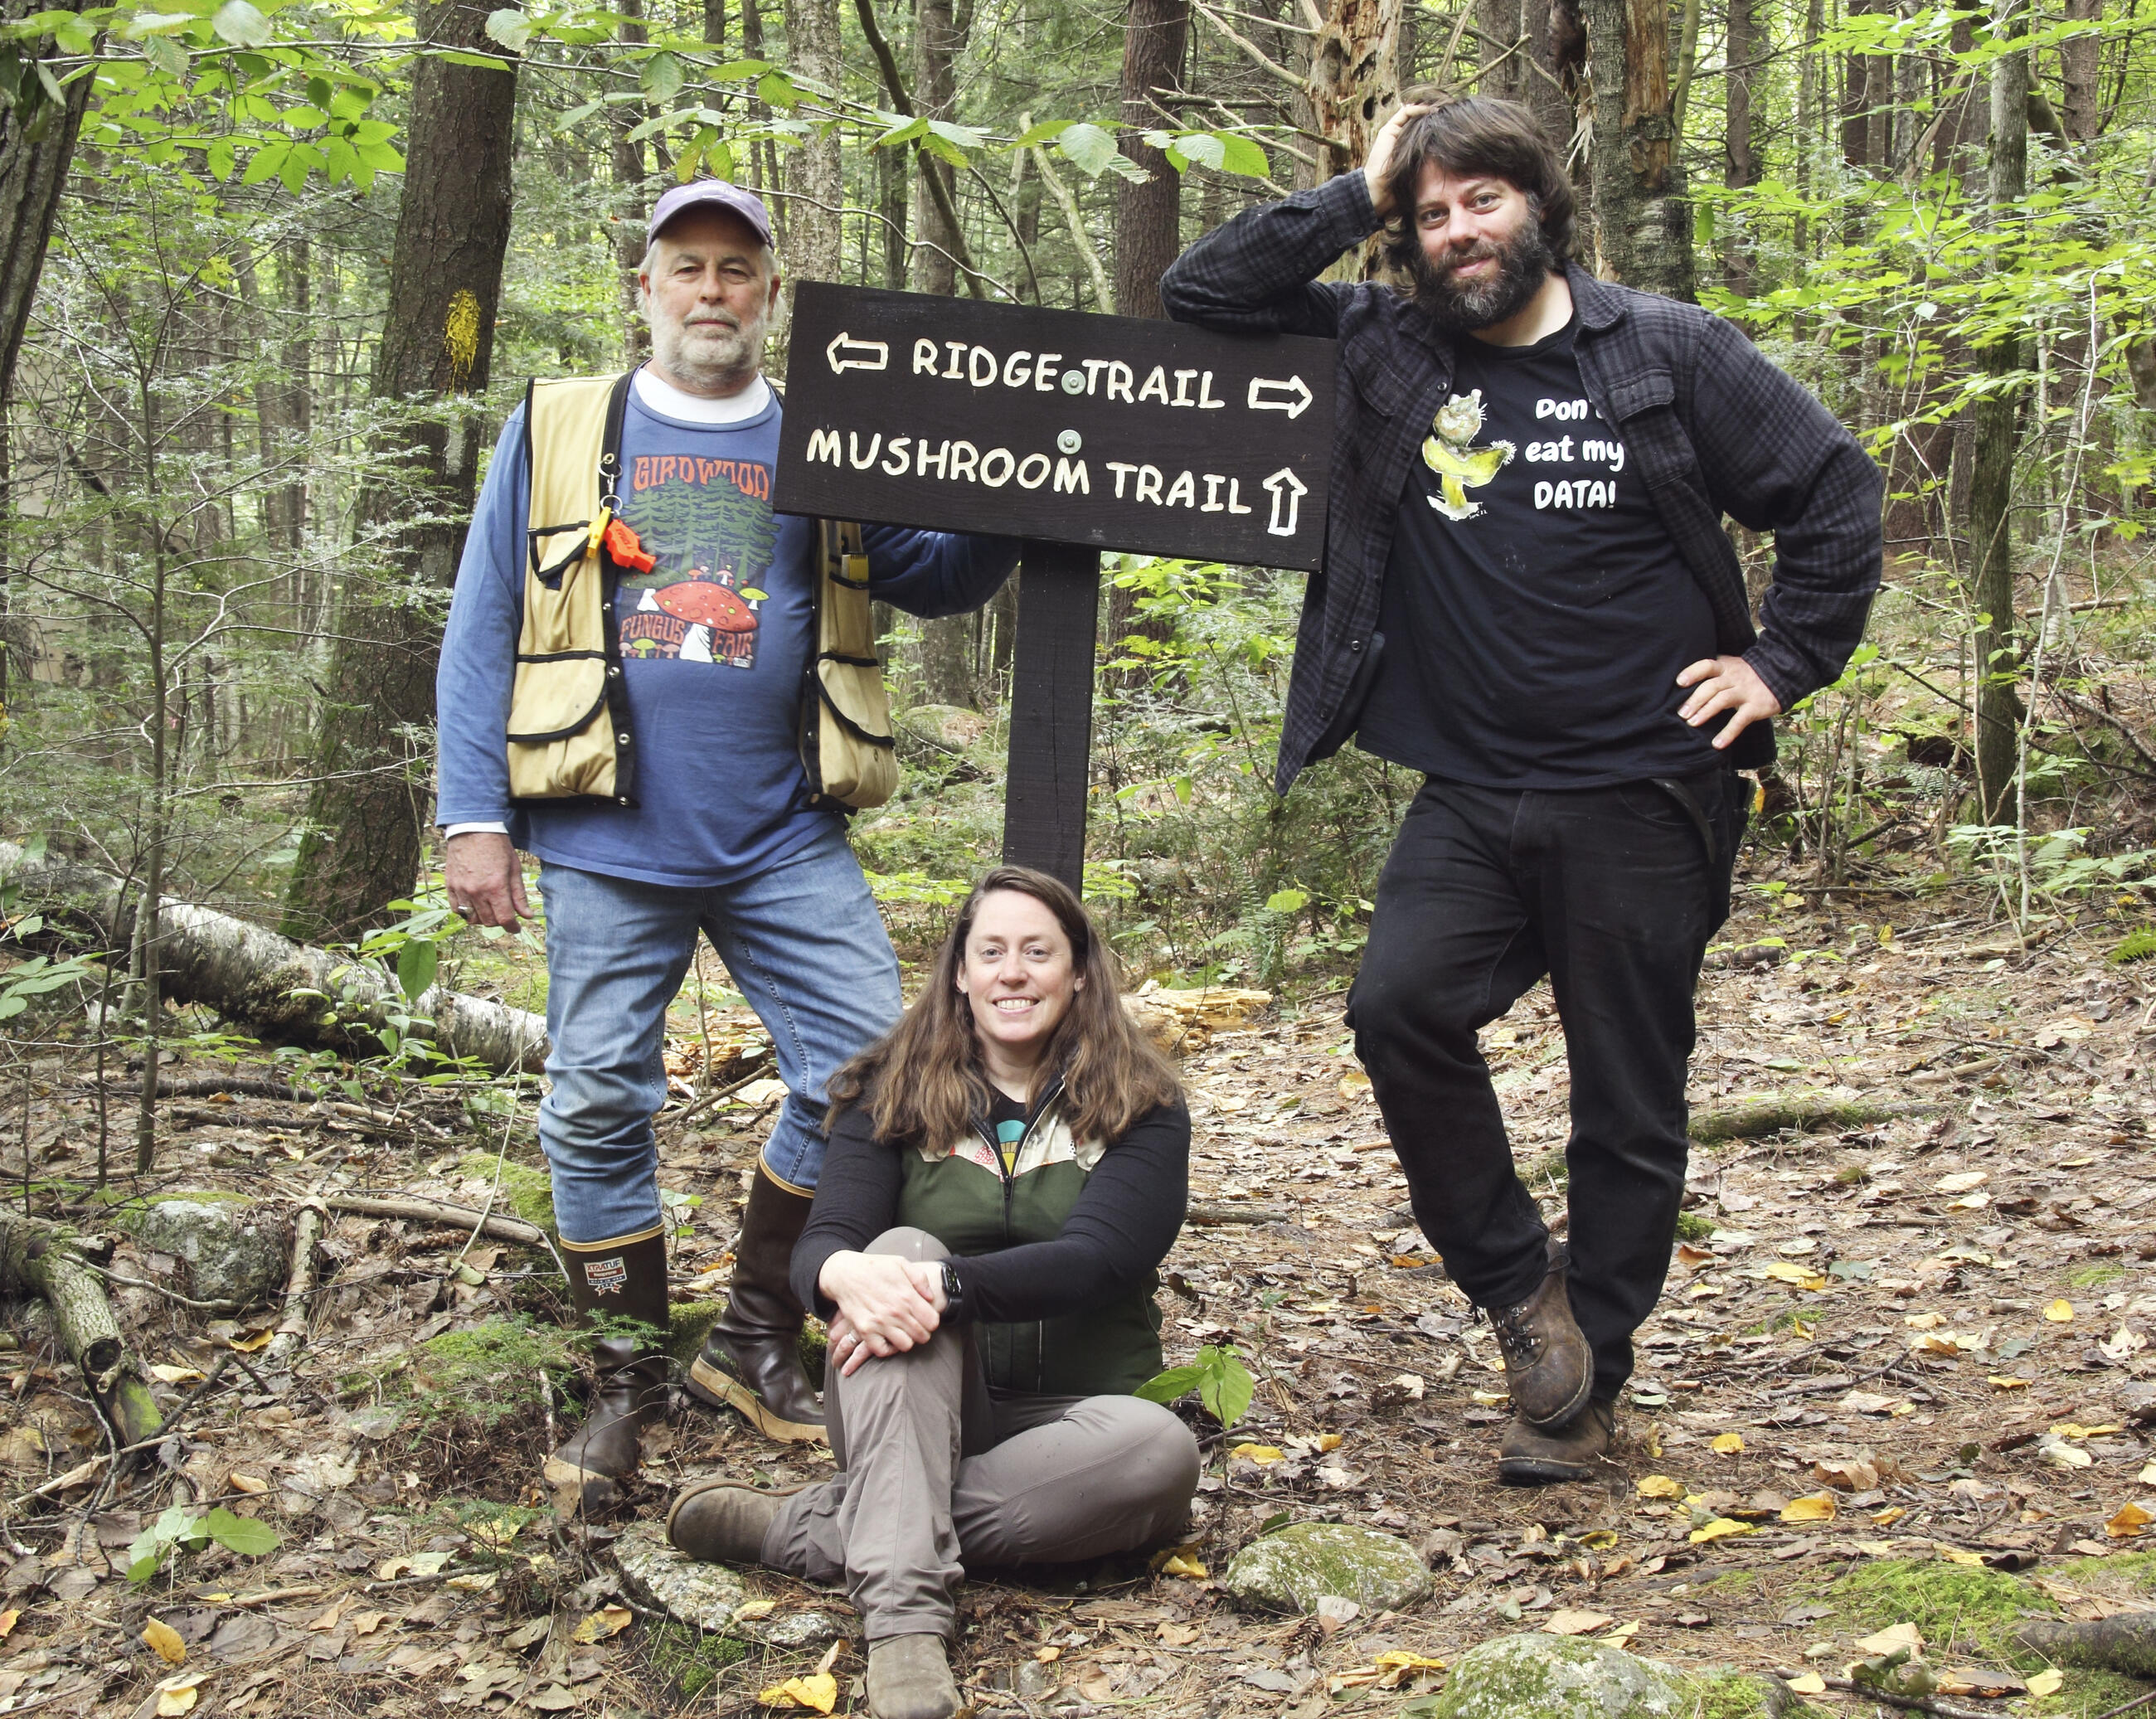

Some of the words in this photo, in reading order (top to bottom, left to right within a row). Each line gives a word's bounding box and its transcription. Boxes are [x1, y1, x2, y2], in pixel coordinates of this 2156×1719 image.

[913, 337, 1061, 391] RIDGE
[1081, 358, 1225, 409] TRAIL
[1536, 398, 1605, 421] Don
[1525, 435, 1575, 463] eat
[1582, 439, 1625, 473] my
[806, 428, 1090, 495] MUSHROOM
[1105, 461, 1252, 514] TRAIL
[1534, 480, 1616, 510] DATA!
[619, 614, 686, 645] FUNGUS
[711, 629, 754, 657] FAIR
